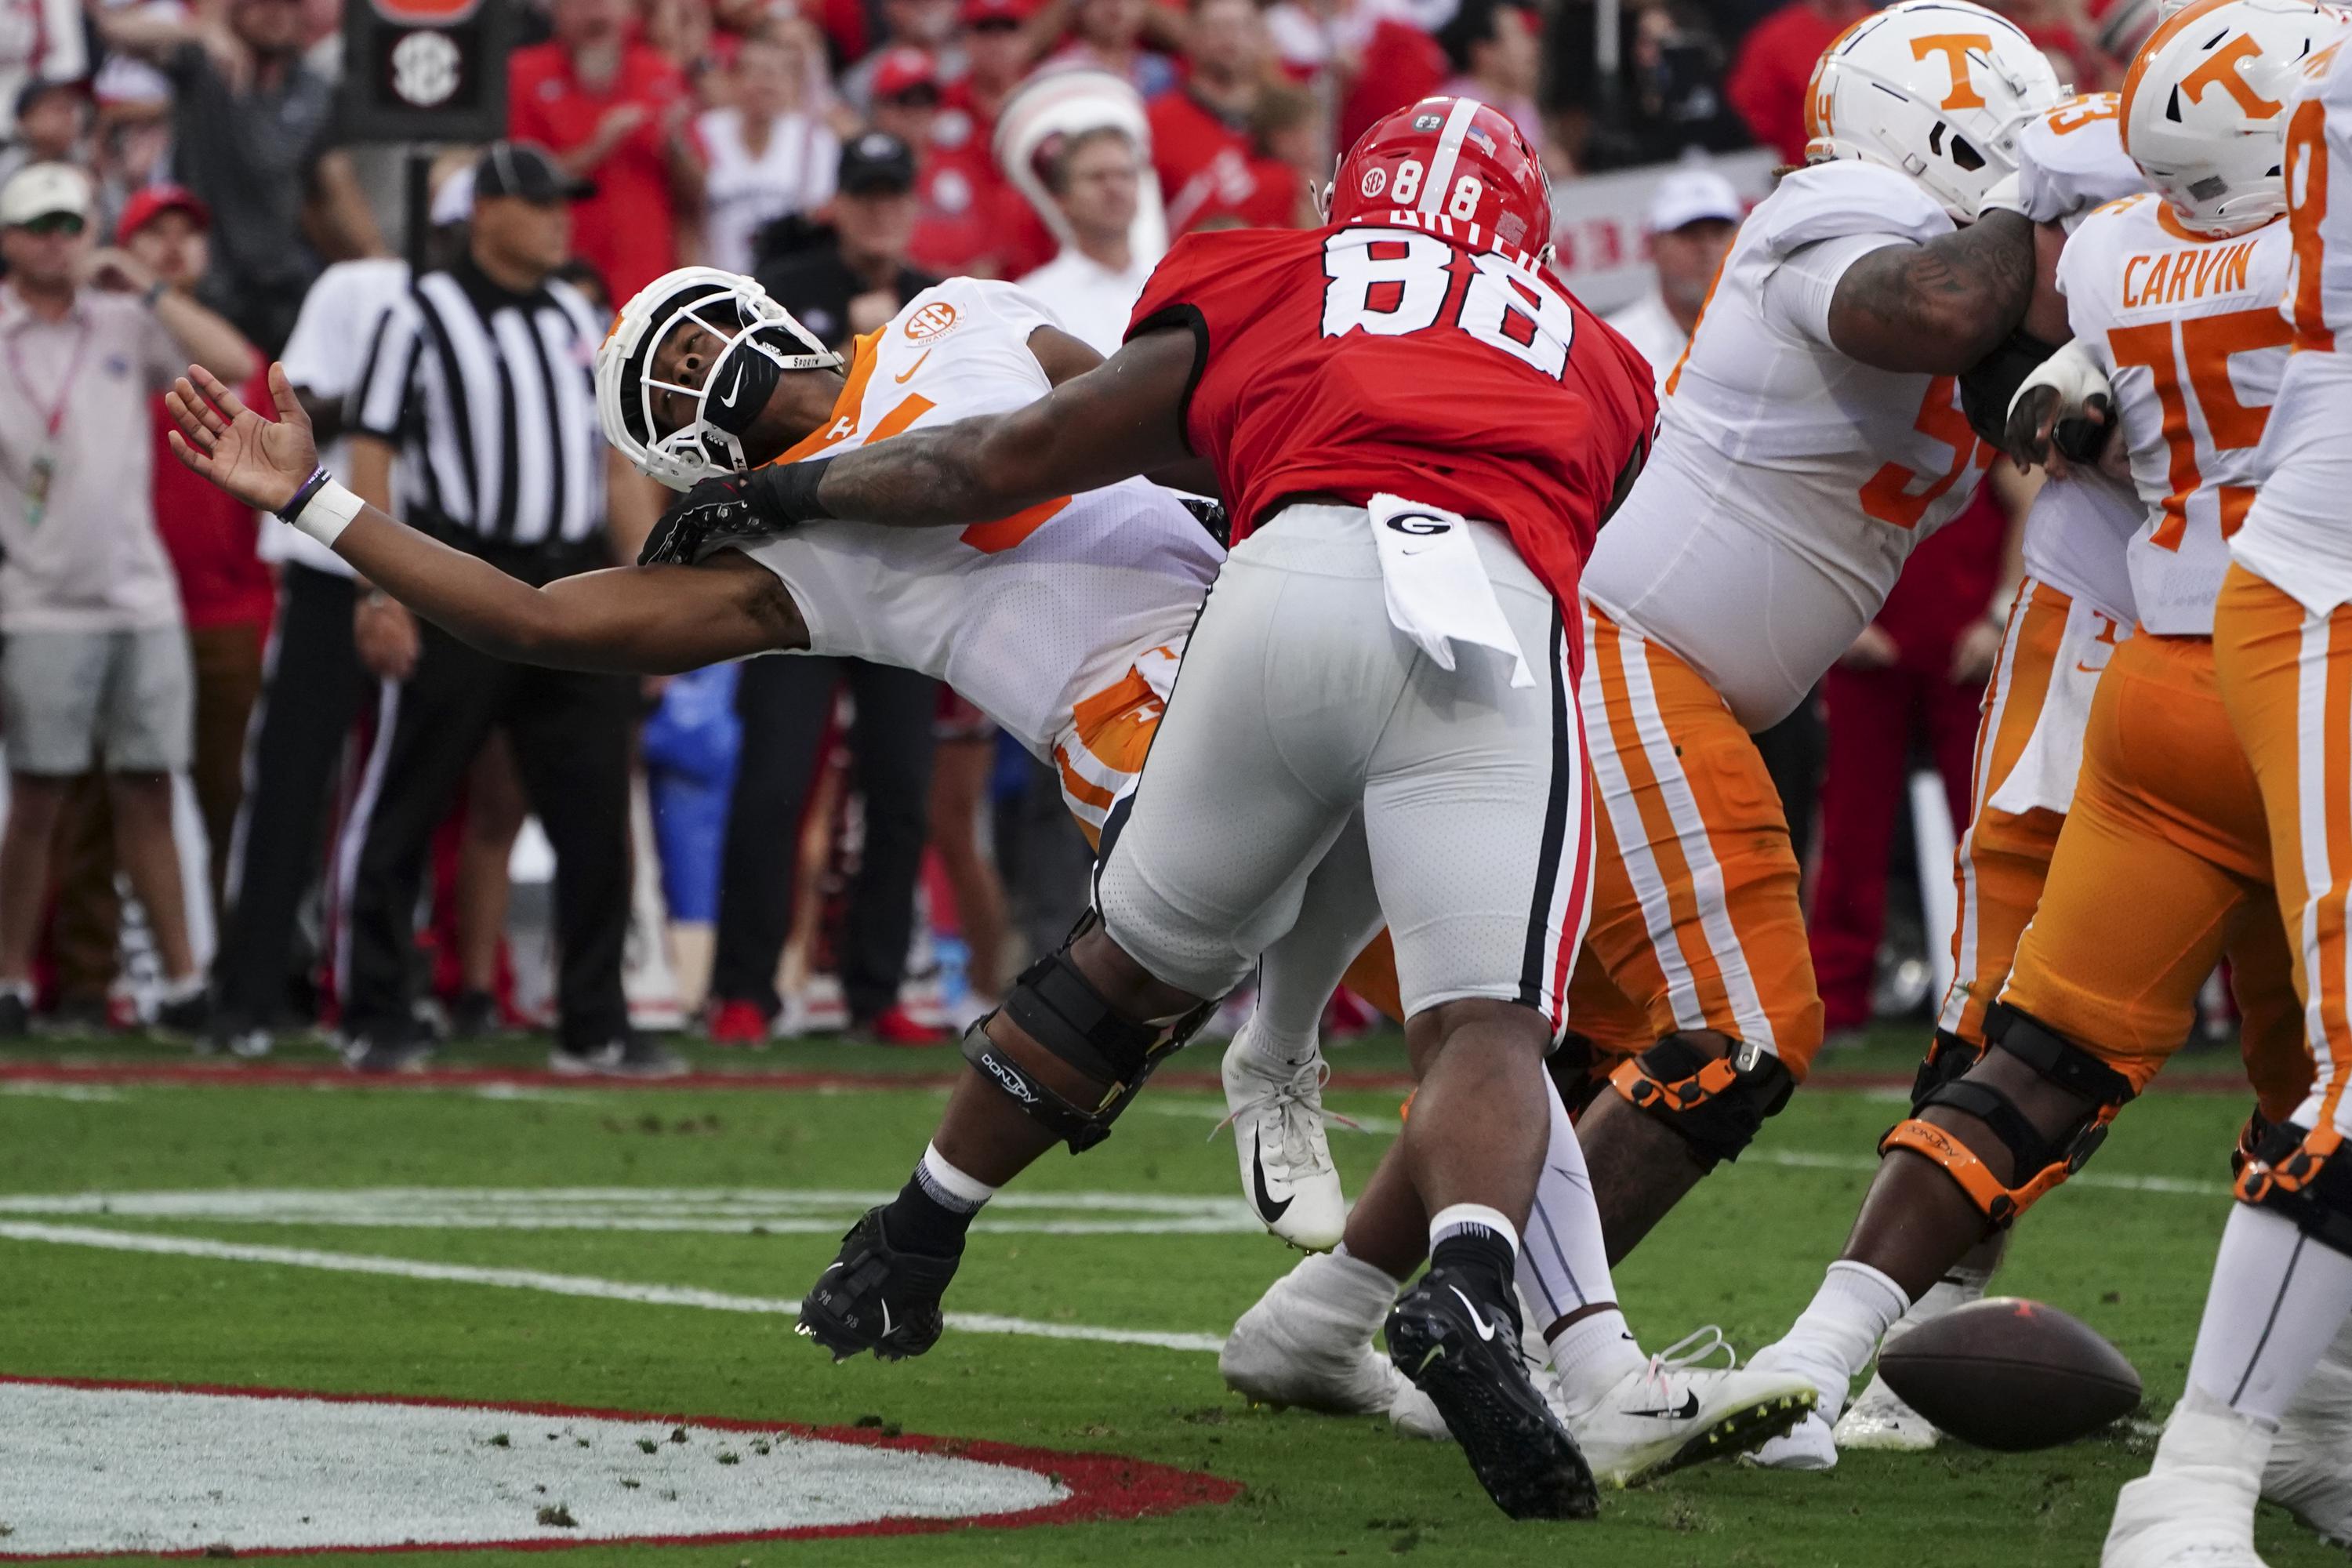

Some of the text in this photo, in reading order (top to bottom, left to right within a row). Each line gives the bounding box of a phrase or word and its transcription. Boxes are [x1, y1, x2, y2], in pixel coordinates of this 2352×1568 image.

[1909, 34, 1993, 111] T
[2180, 32, 2285, 120] T
[1363, 169, 1385, 196] SEC
[2123, 238, 2259, 308] CARVIN
[906, 303, 954, 339] SEC
[1320, 227, 1574, 382] 88
[1386, 514, 1451, 535] G
[818, 1289, 832, 1306] 98
